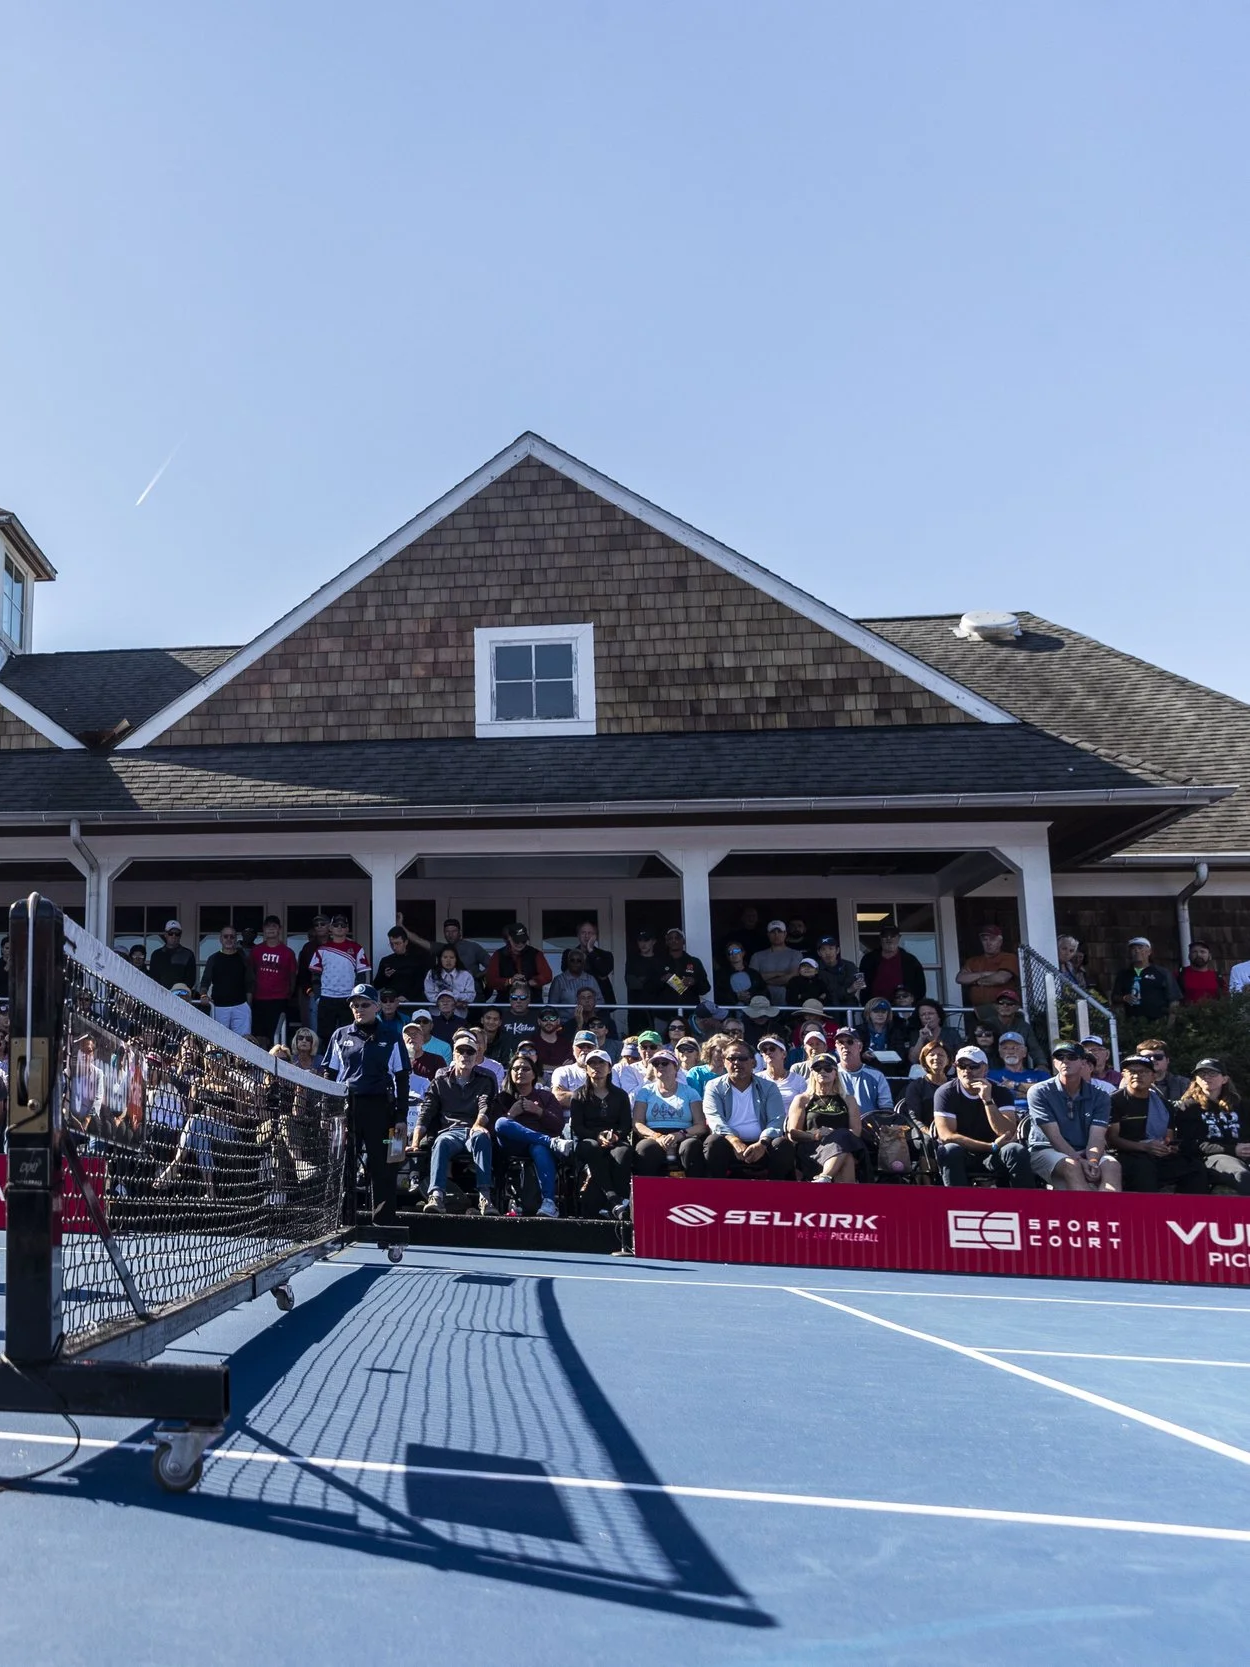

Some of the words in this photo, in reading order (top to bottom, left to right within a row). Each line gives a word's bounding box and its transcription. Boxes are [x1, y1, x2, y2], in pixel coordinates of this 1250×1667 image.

[262, 952, 280, 964] CITI
[513, 1022, 535, 1035] Kitchen
[723, 1209, 880, 1230] SELKIRK
[1028, 1218, 1120, 1234] SPORT
[830, 1231, 879, 1243] PICKLEBALL
[1029, 1235, 1122, 1250] COURT
[1208, 1251, 1250, 1269] PIC
